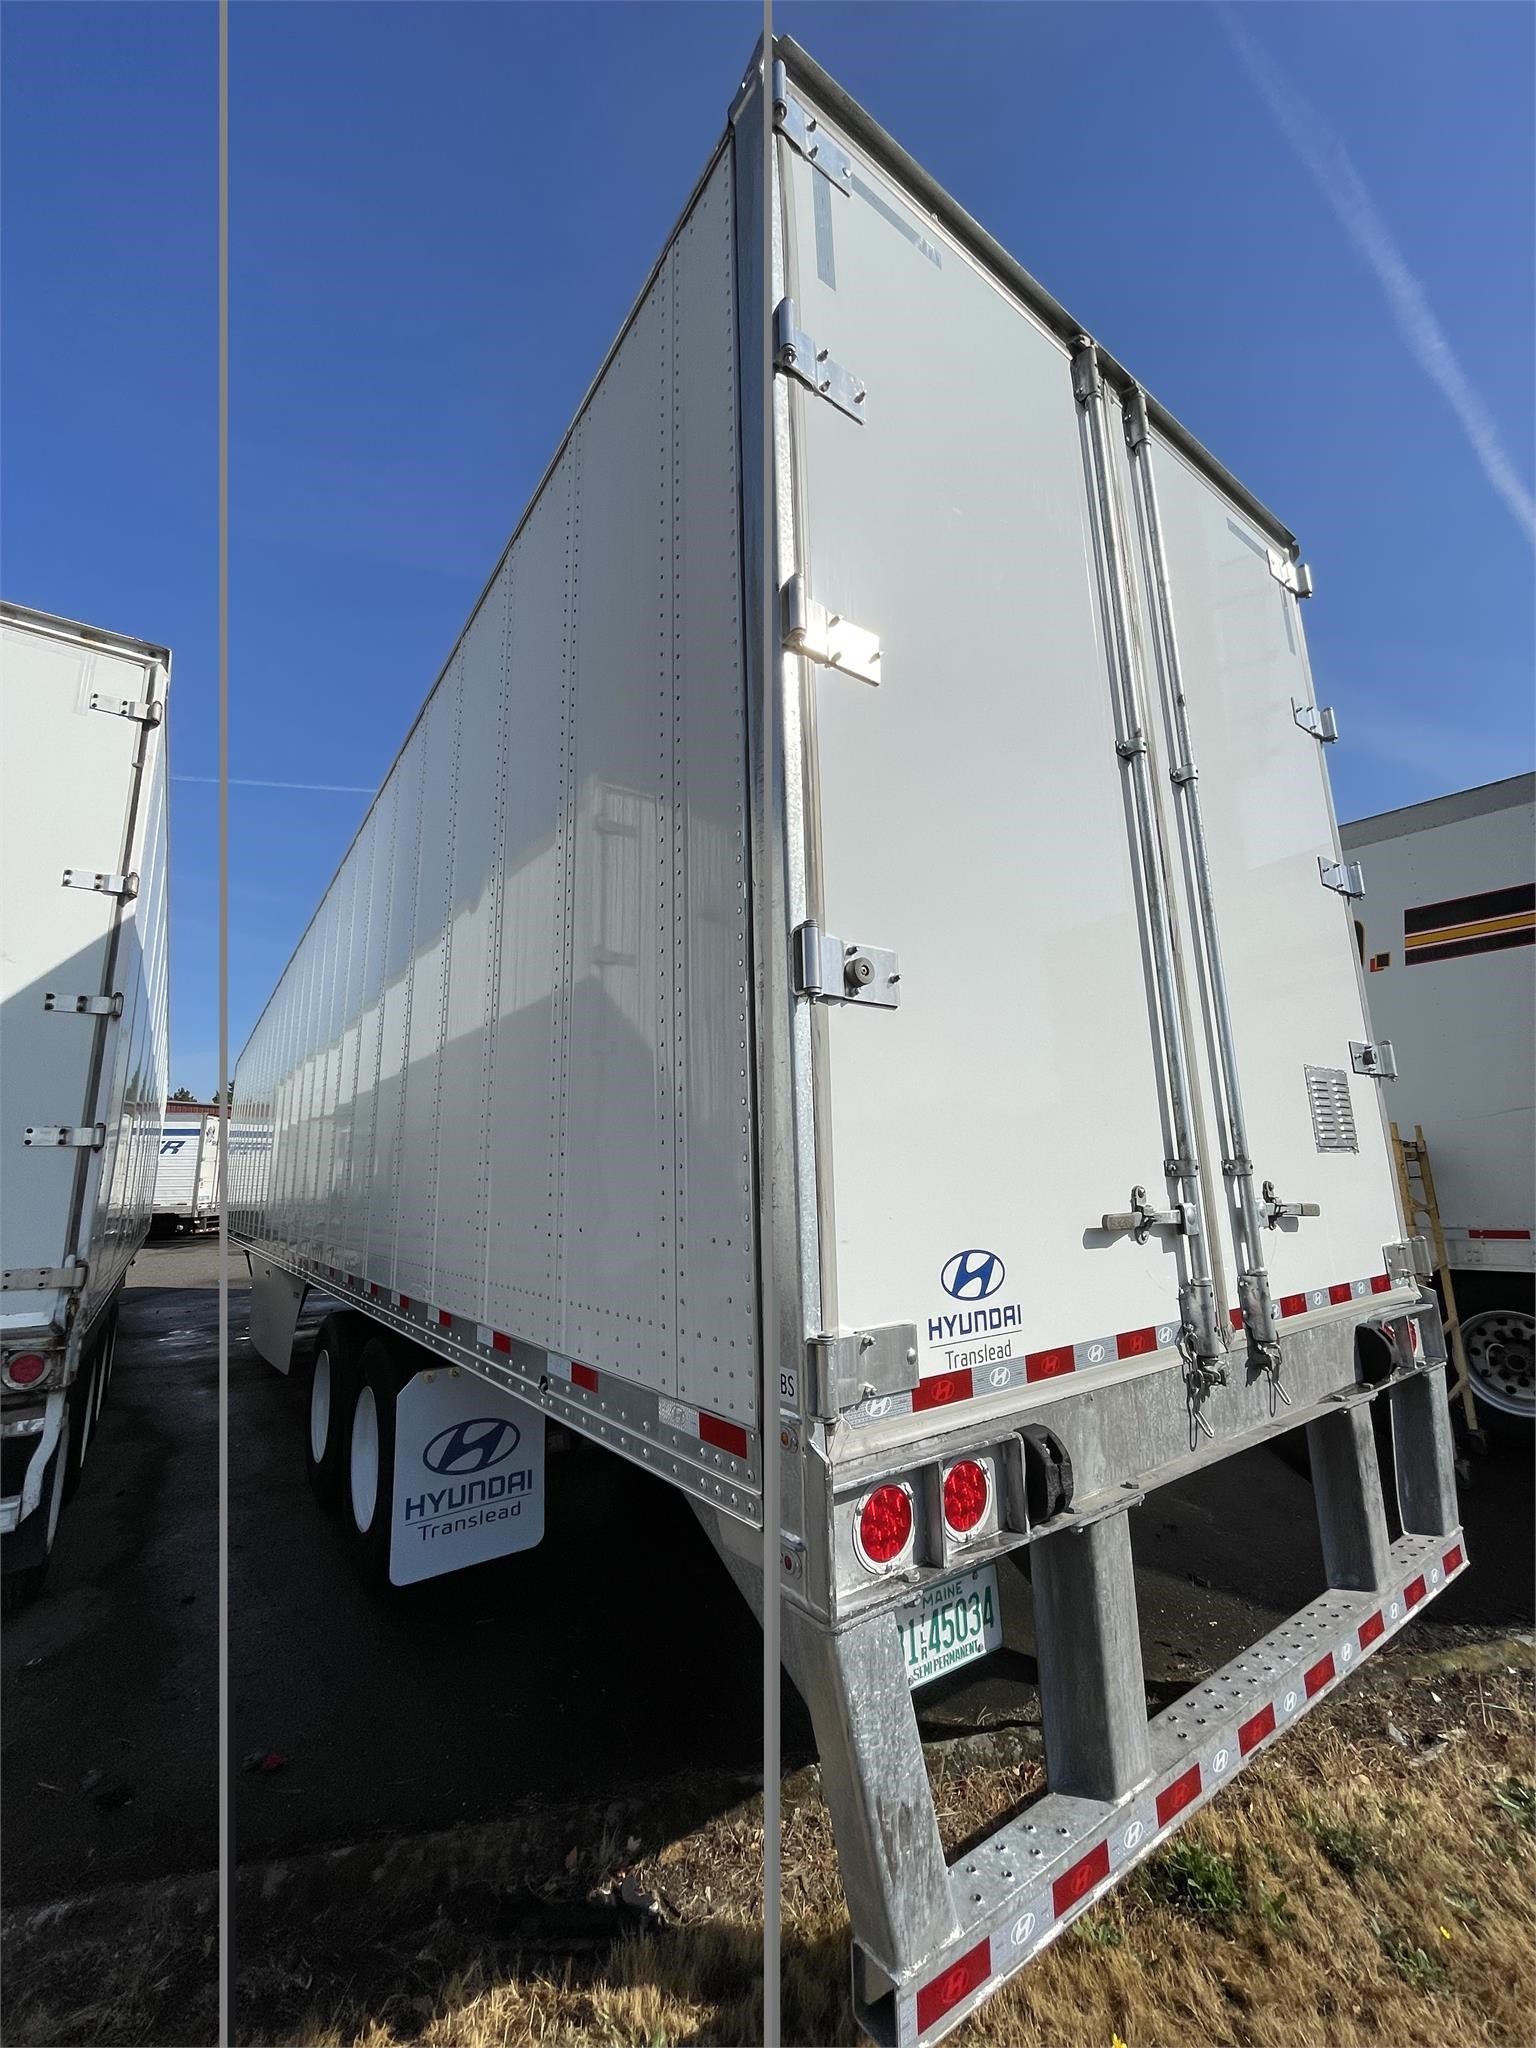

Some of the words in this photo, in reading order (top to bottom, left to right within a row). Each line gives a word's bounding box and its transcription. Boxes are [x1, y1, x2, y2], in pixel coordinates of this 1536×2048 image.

[928, 1304, 1021, 1341] HYUNDAI
[945, 1339, 1012, 1370] Translead
[780, 1372, 795, 1397] BS
[405, 1469, 532, 1520] HYUNDAI
[418, 1501, 520, 1541] Translead
[922, 1581, 962, 1608] MAINE
[929, 1586, 994, 1653] 45034
[913, 1661, 933, 1680] SEMI
[933, 1640, 980, 1672] PERMANENT
